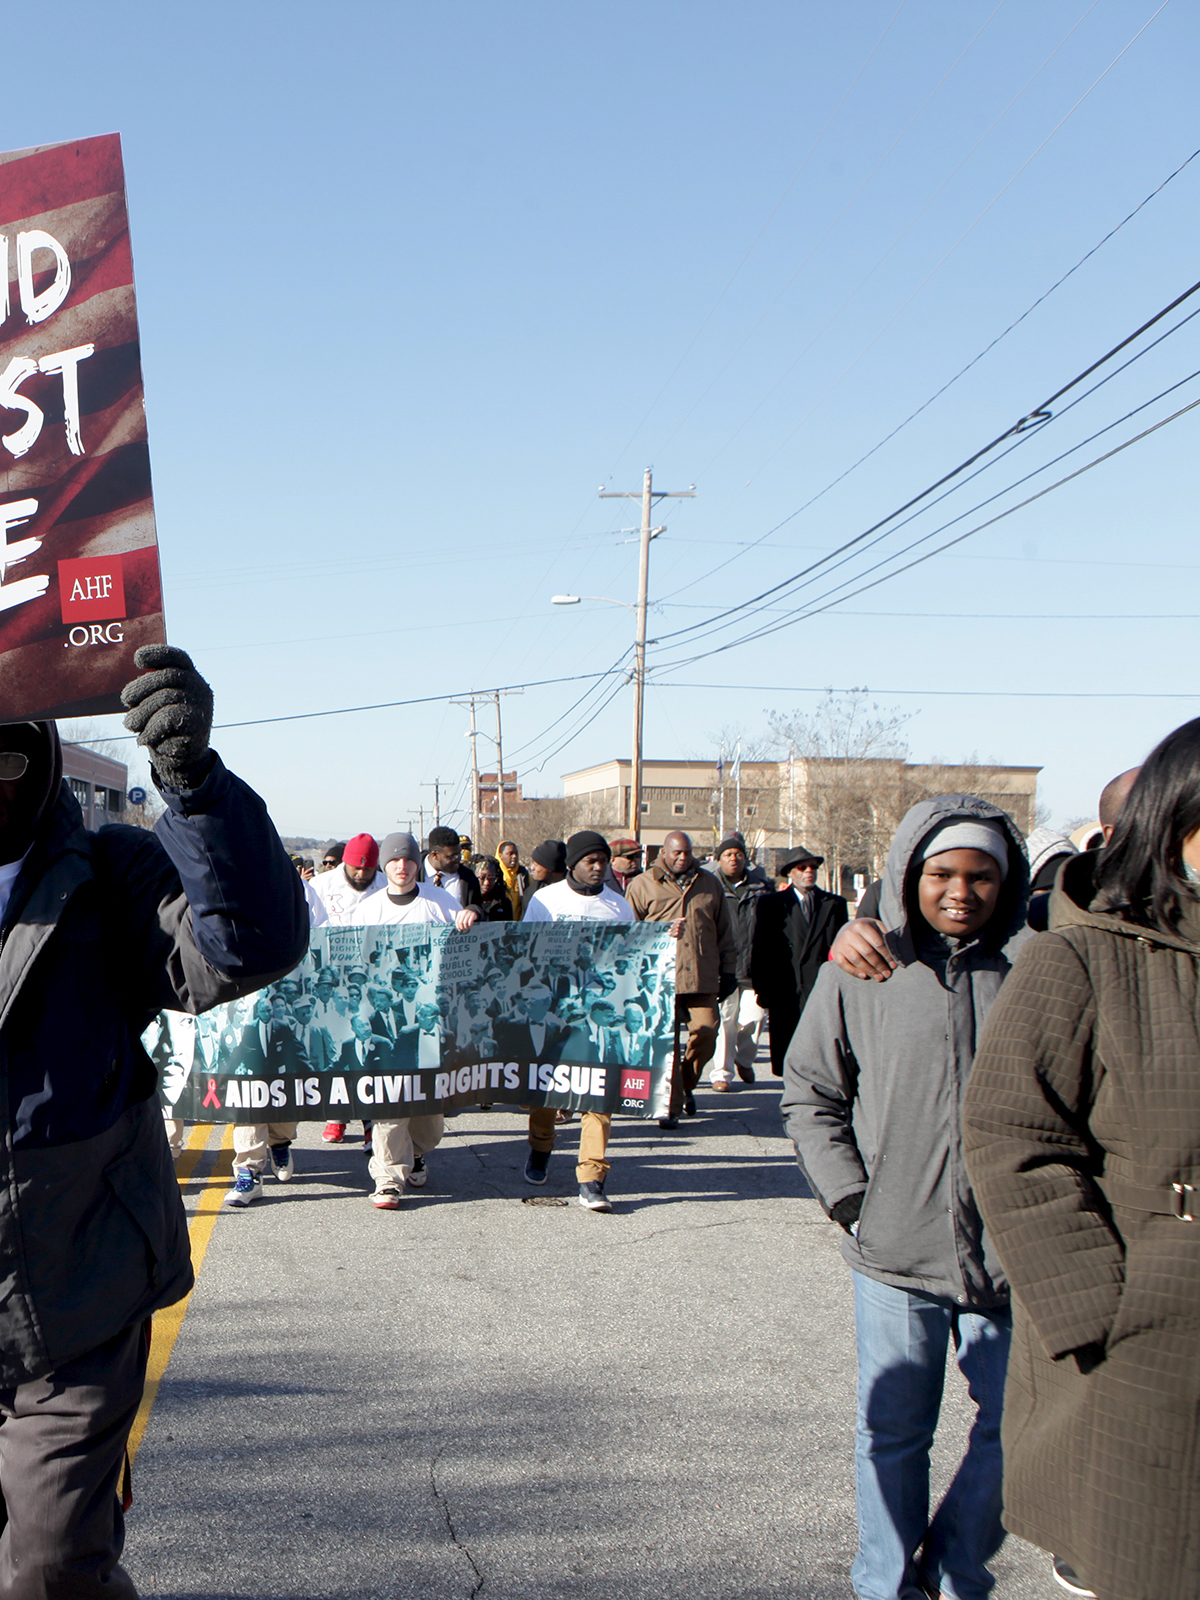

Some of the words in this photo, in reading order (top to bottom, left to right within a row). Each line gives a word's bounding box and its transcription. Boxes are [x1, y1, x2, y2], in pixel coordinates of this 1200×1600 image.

[69, 575, 114, 602] AHF
[63, 621, 124, 648] .ORG
[132, 791, 142, 801] P
[433, 935, 479, 947] SEGREGATED
[440, 944, 471, 955] RULES
[329, 952, 362, 962] NOW!
[439, 959, 472, 972] PUBLIC
[437, 968, 473, 982] SCHOOLS
[225, 1079, 287, 1108] AIDS
[294, 1077, 321, 1107] IS
[329, 1076, 350, 1106] A
[356, 1074, 426, 1105] CIVIL
[434, 1061, 521, 1100] RIGHTS
[528, 1063, 607, 1097] ISSUE
[623, 1077, 646, 1091] AHF
[620, 1099, 645, 1109] .ORG
